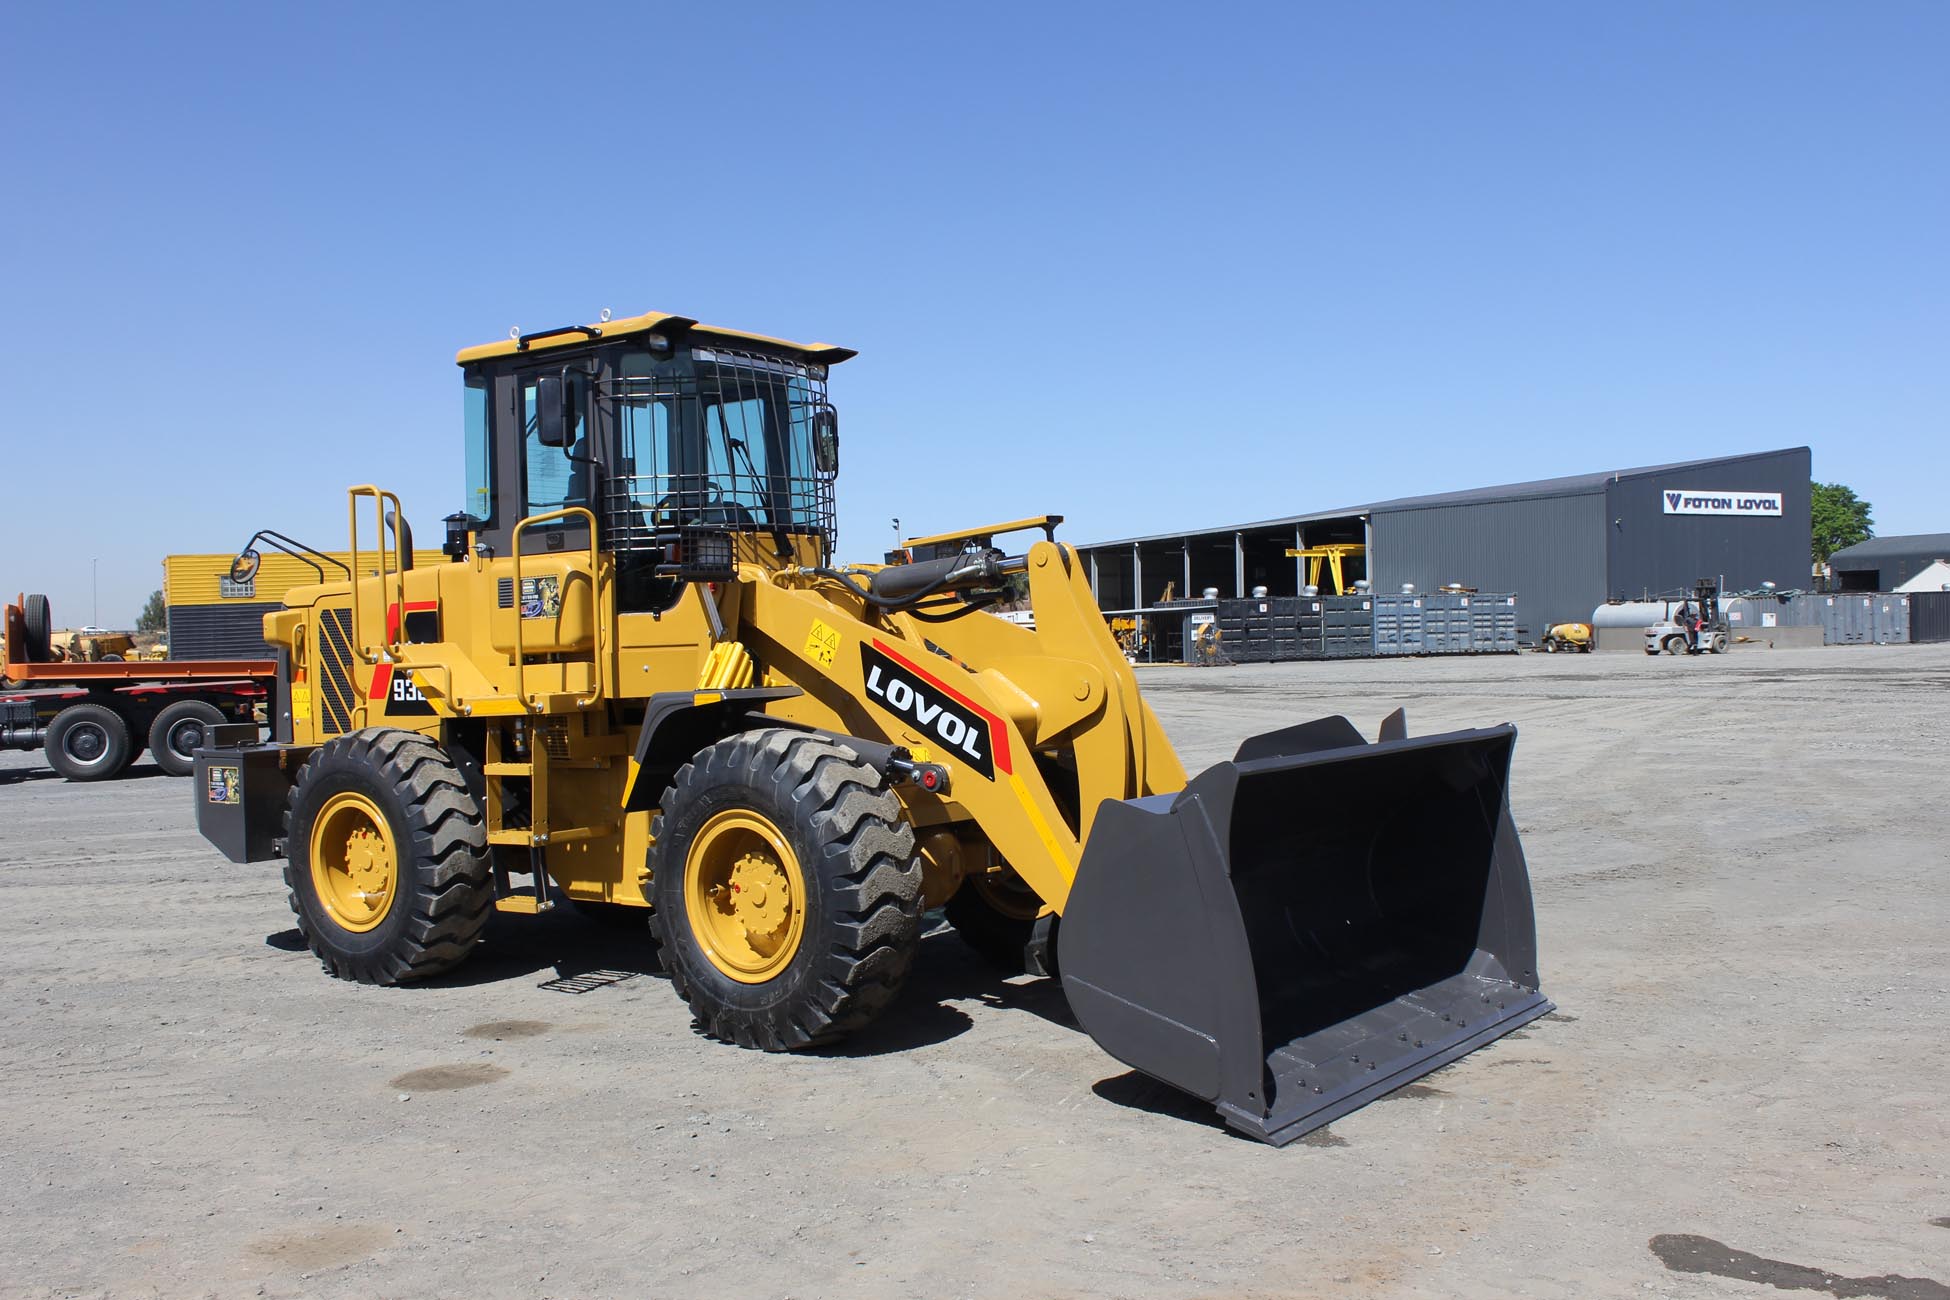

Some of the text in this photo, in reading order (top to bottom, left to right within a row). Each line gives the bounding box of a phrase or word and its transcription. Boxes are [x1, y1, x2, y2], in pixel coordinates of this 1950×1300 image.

[1684, 497, 1779, 510] FOTON LOVOL
[866, 665, 982, 760] LOVOL
